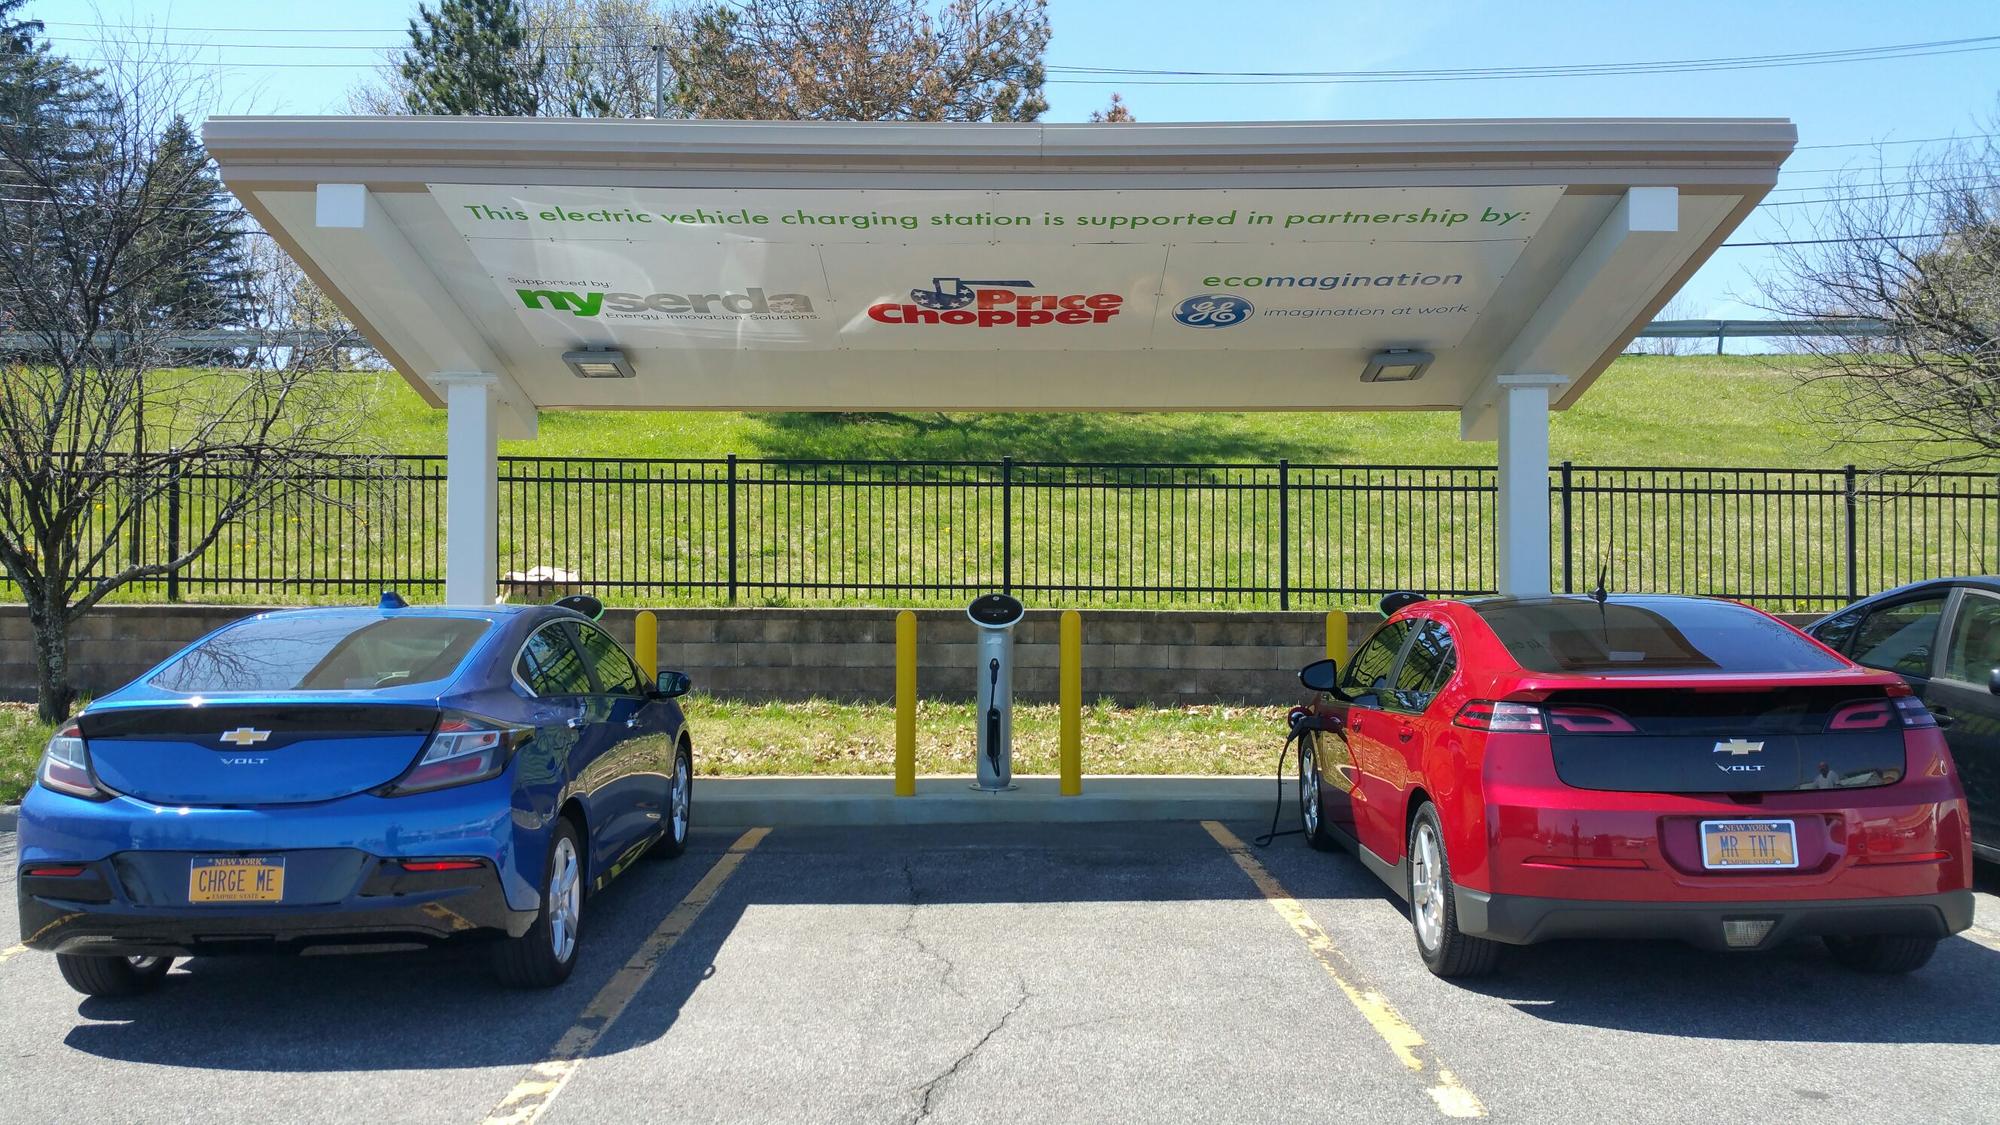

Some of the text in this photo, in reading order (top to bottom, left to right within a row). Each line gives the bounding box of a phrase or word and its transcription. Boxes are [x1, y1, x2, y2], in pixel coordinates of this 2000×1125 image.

[464, 205, 1531, 230] This electric vehicle charging station is supported in partnership by:
[507, 277, 613, 288] Supported by:
[1202, 272, 1463, 290] ecomagination
[515, 287, 815, 317] nyserda
[976, 289, 1124, 310] Price
[868, 303, 1120, 328] Chopper
[1264, 304, 1470, 319] imagination at work
[1715, 762, 1765, 774] VOLT
[1720, 835, 1776, 857] MR TNT
[215, 858, 262, 866] NEW YORK
[199, 869, 275, 892] CHRGE ME
